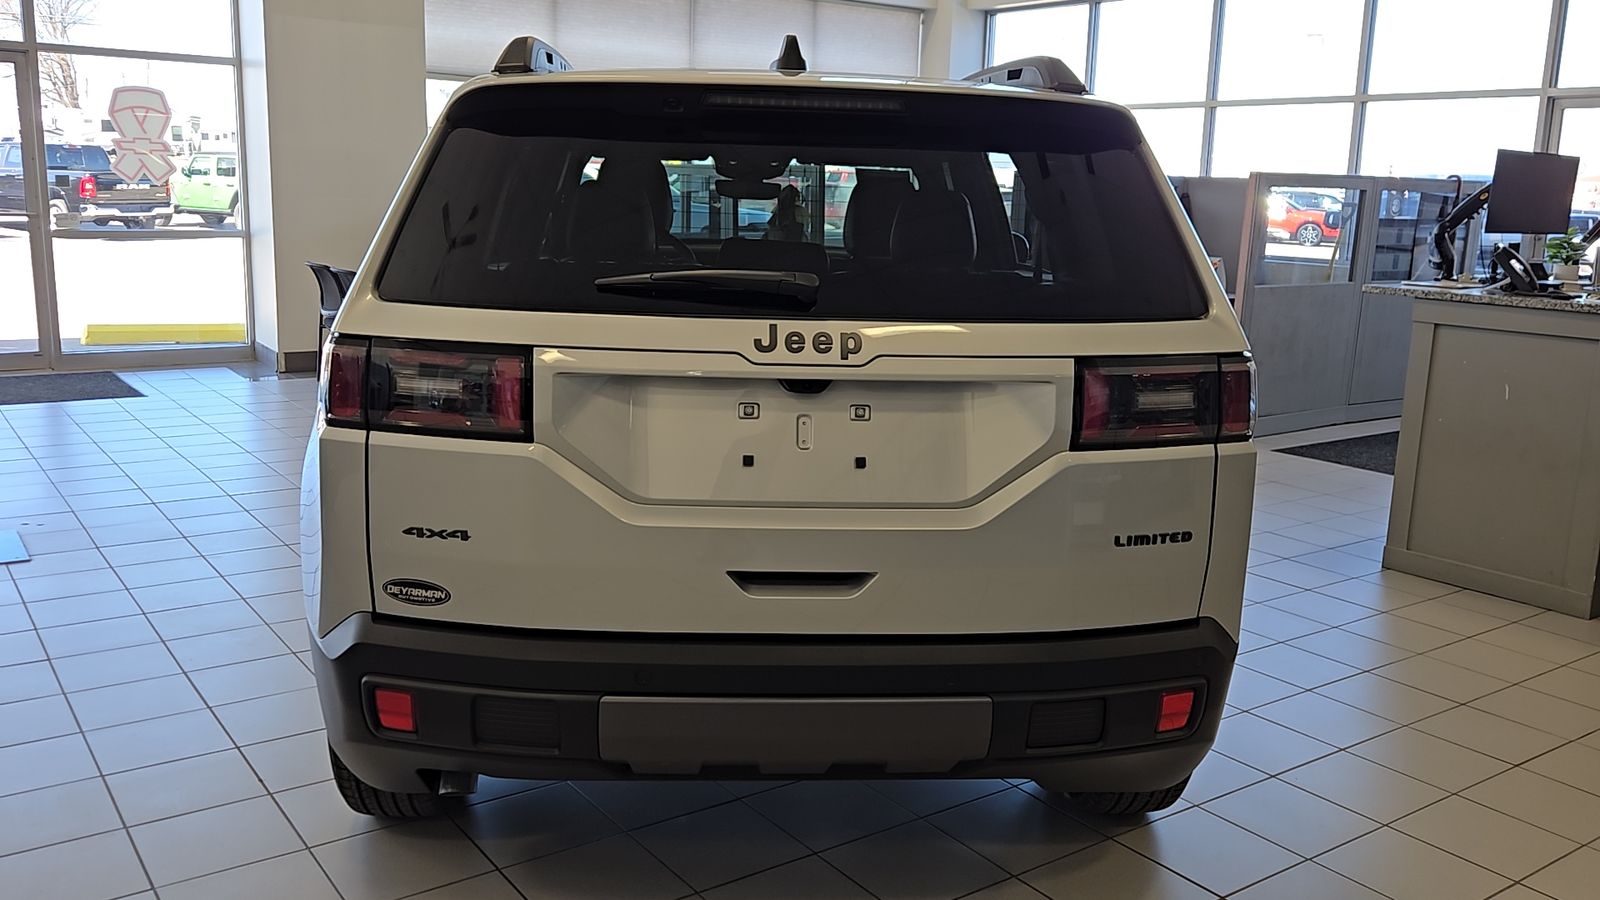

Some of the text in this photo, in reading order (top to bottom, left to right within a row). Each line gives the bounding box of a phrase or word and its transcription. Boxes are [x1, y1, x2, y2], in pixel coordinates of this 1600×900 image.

[753, 323, 863, 361] Jeep
[401, 526, 472, 542] 4x4
[1113, 530, 1194, 548] LIMITED
[387, 584, 447, 599] DEYARMAN
